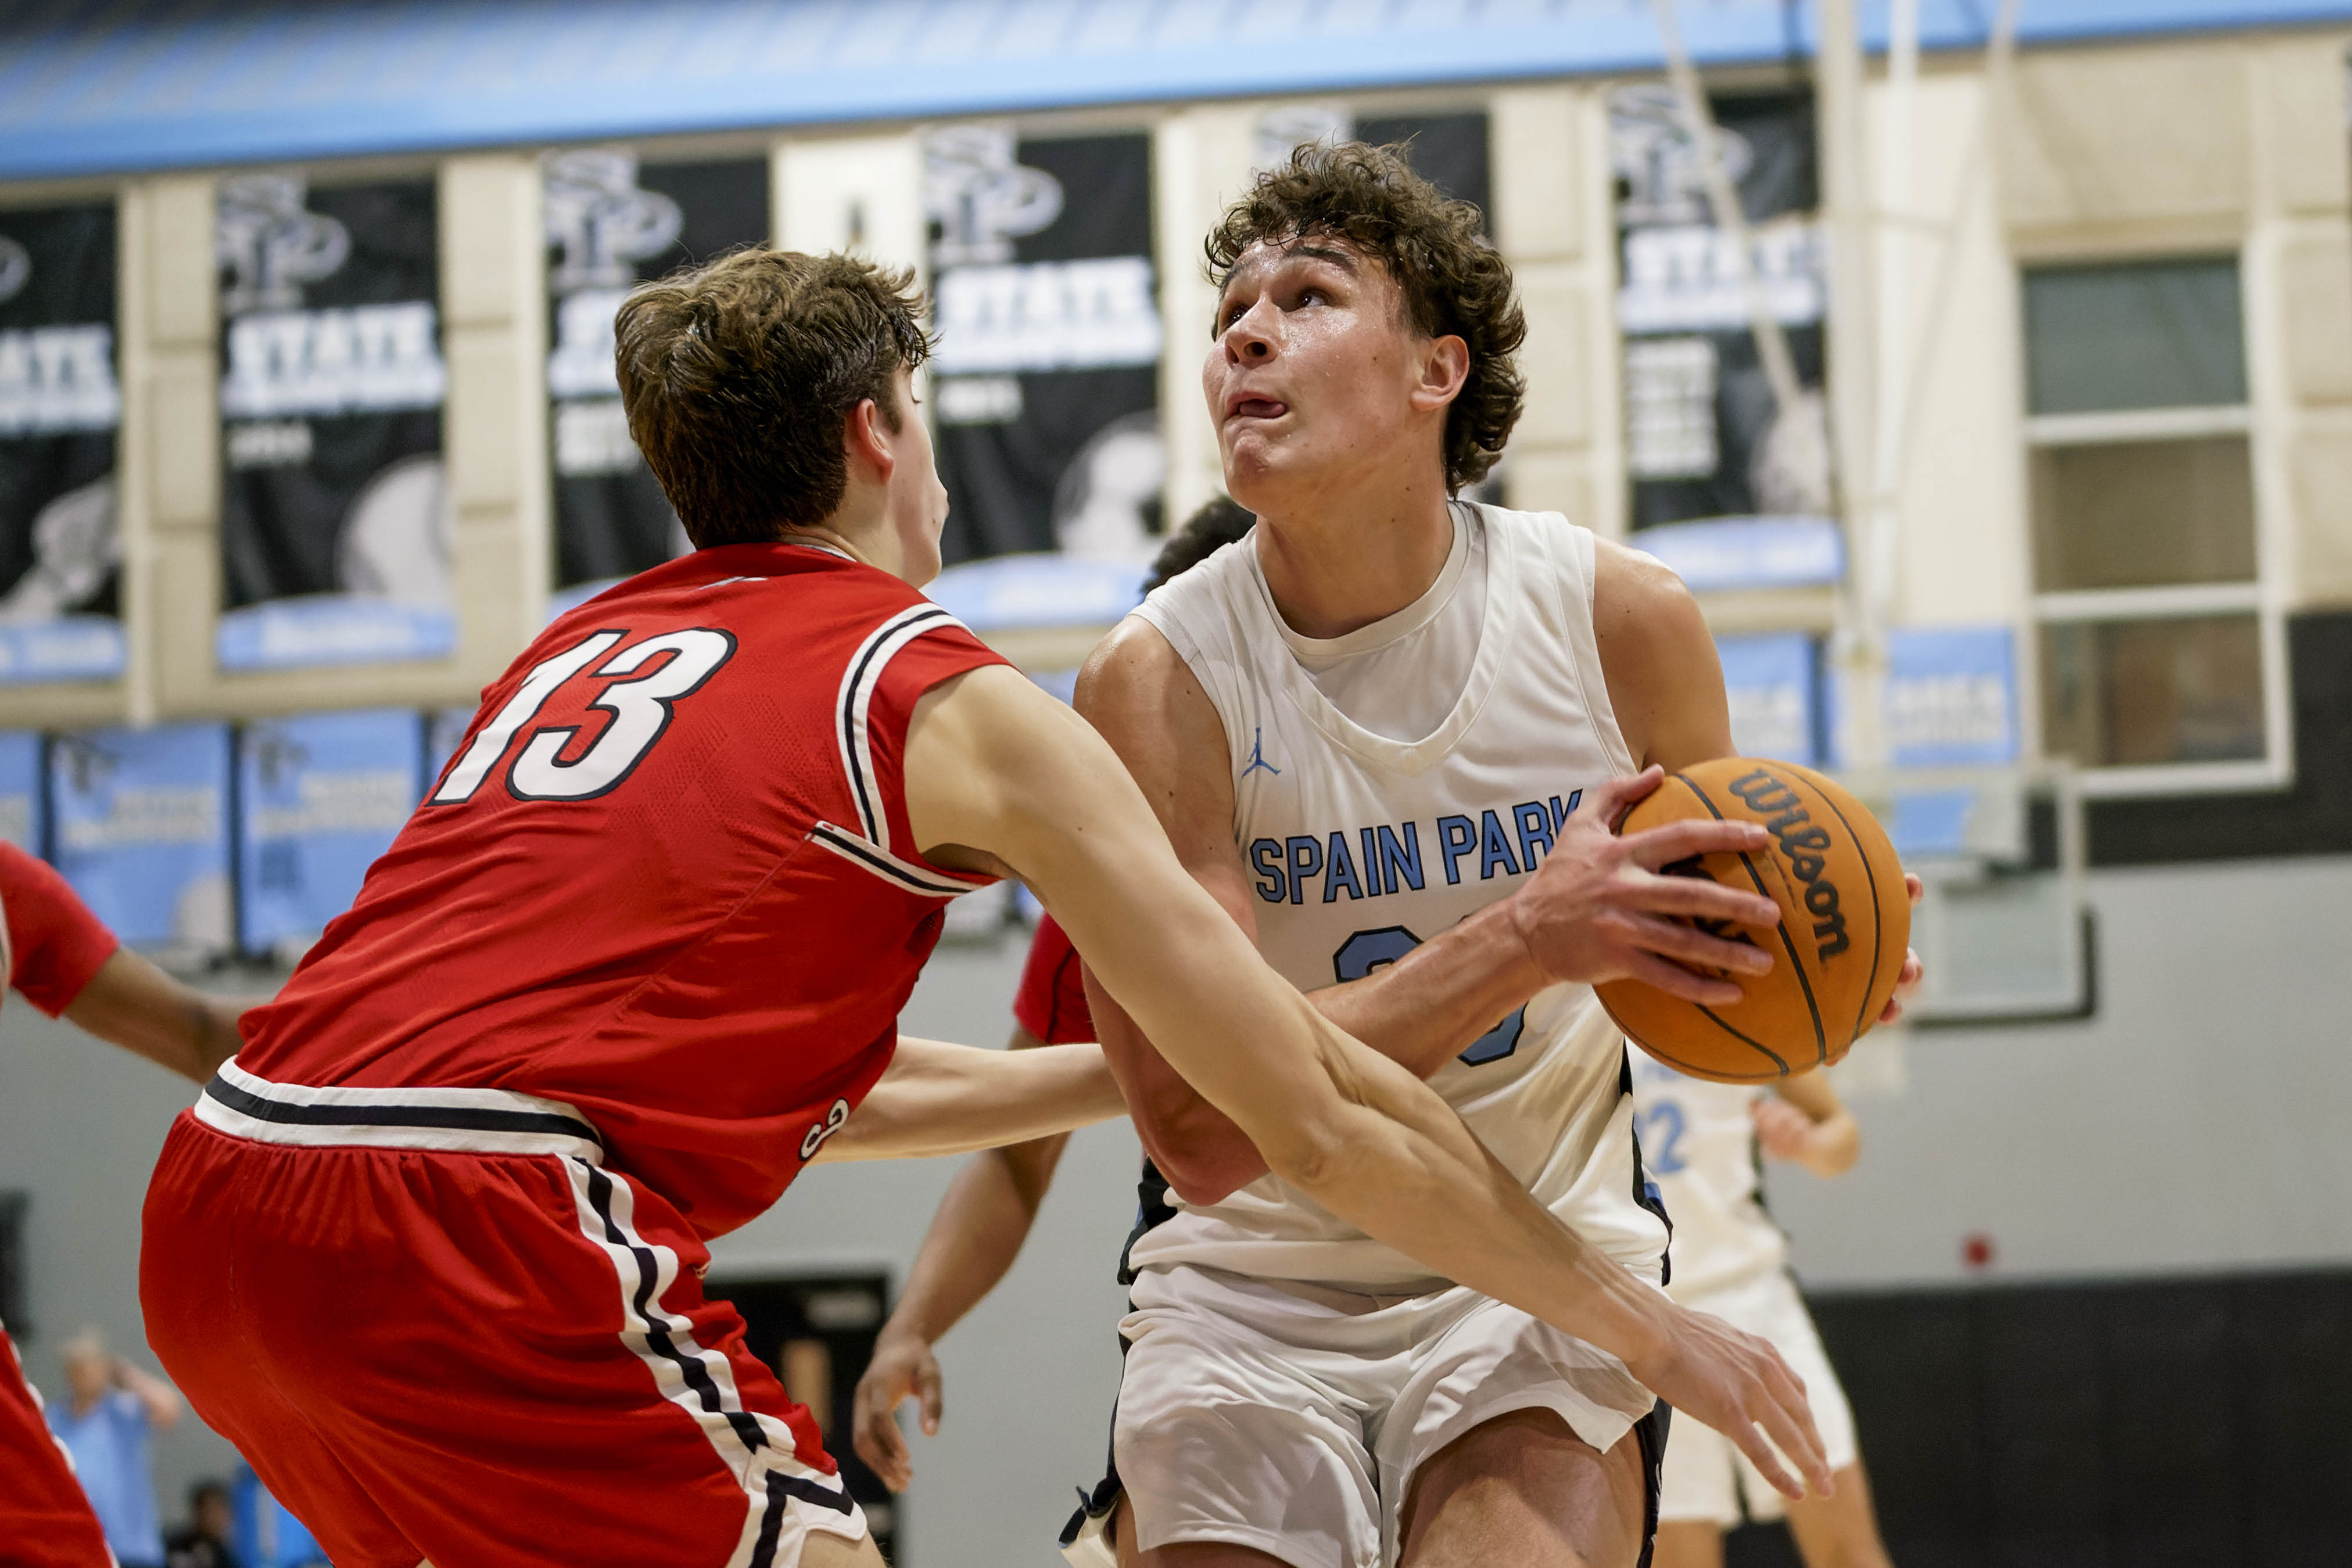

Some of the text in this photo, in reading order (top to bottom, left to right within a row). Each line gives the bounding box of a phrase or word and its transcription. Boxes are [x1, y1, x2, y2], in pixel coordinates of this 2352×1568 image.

[425, 626, 737, 807] 13
[1250, 821, 1425, 905] SPAIN
[1728, 767, 1850, 967] Wilson
